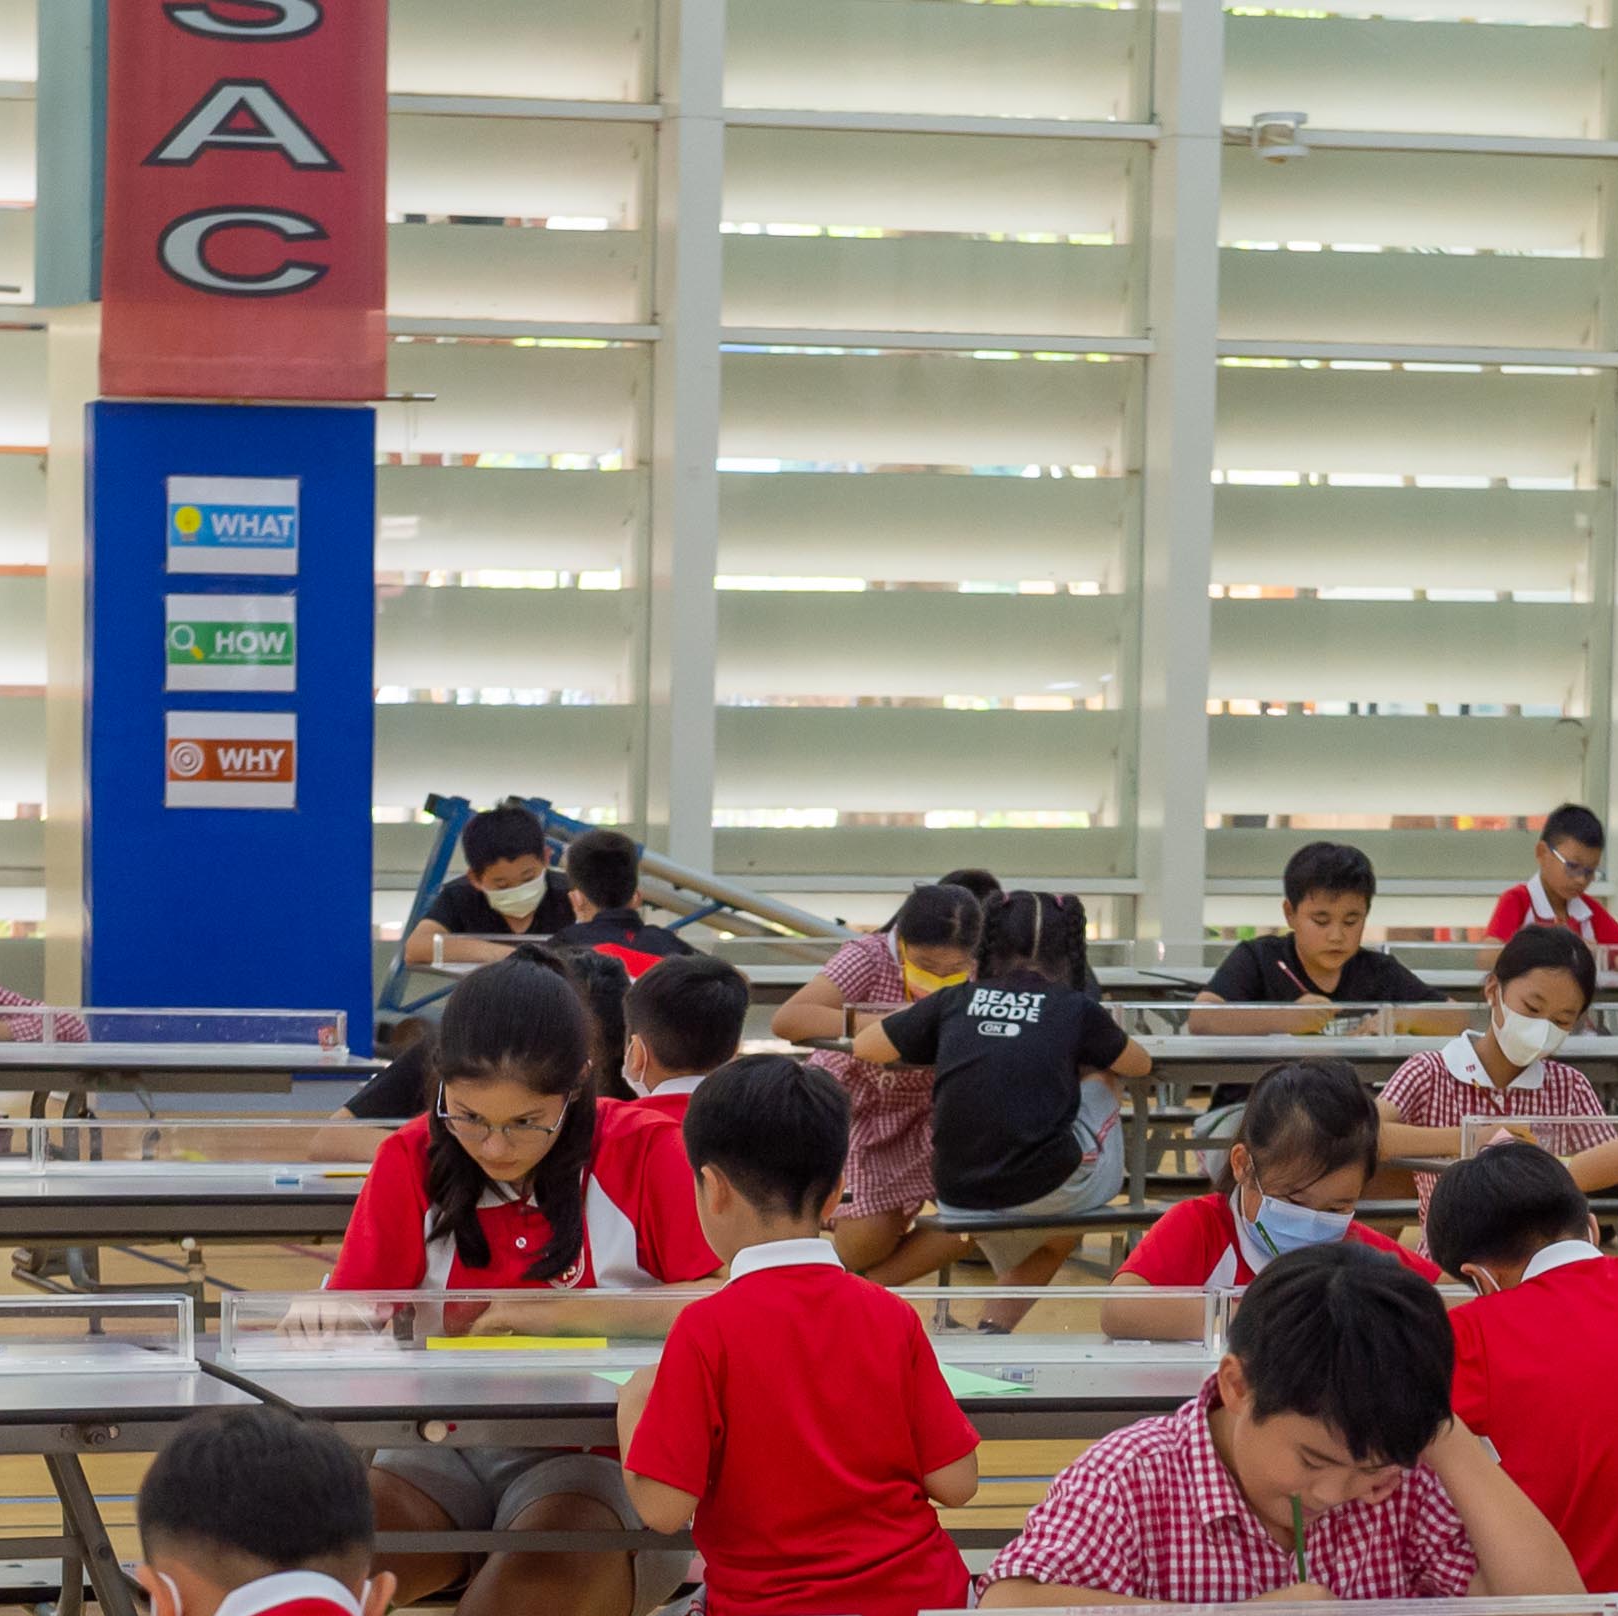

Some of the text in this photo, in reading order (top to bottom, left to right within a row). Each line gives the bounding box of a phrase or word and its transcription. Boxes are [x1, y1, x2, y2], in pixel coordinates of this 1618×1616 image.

[211, 513, 294, 537] WHAT
[215, 630, 286, 653] HOW
[217, 748, 285, 771] WHY
[972, 988, 1046, 1008] BEAST
[967, 1001, 1041, 1023] MODE
[984, 1024, 1002, 1034] ON
